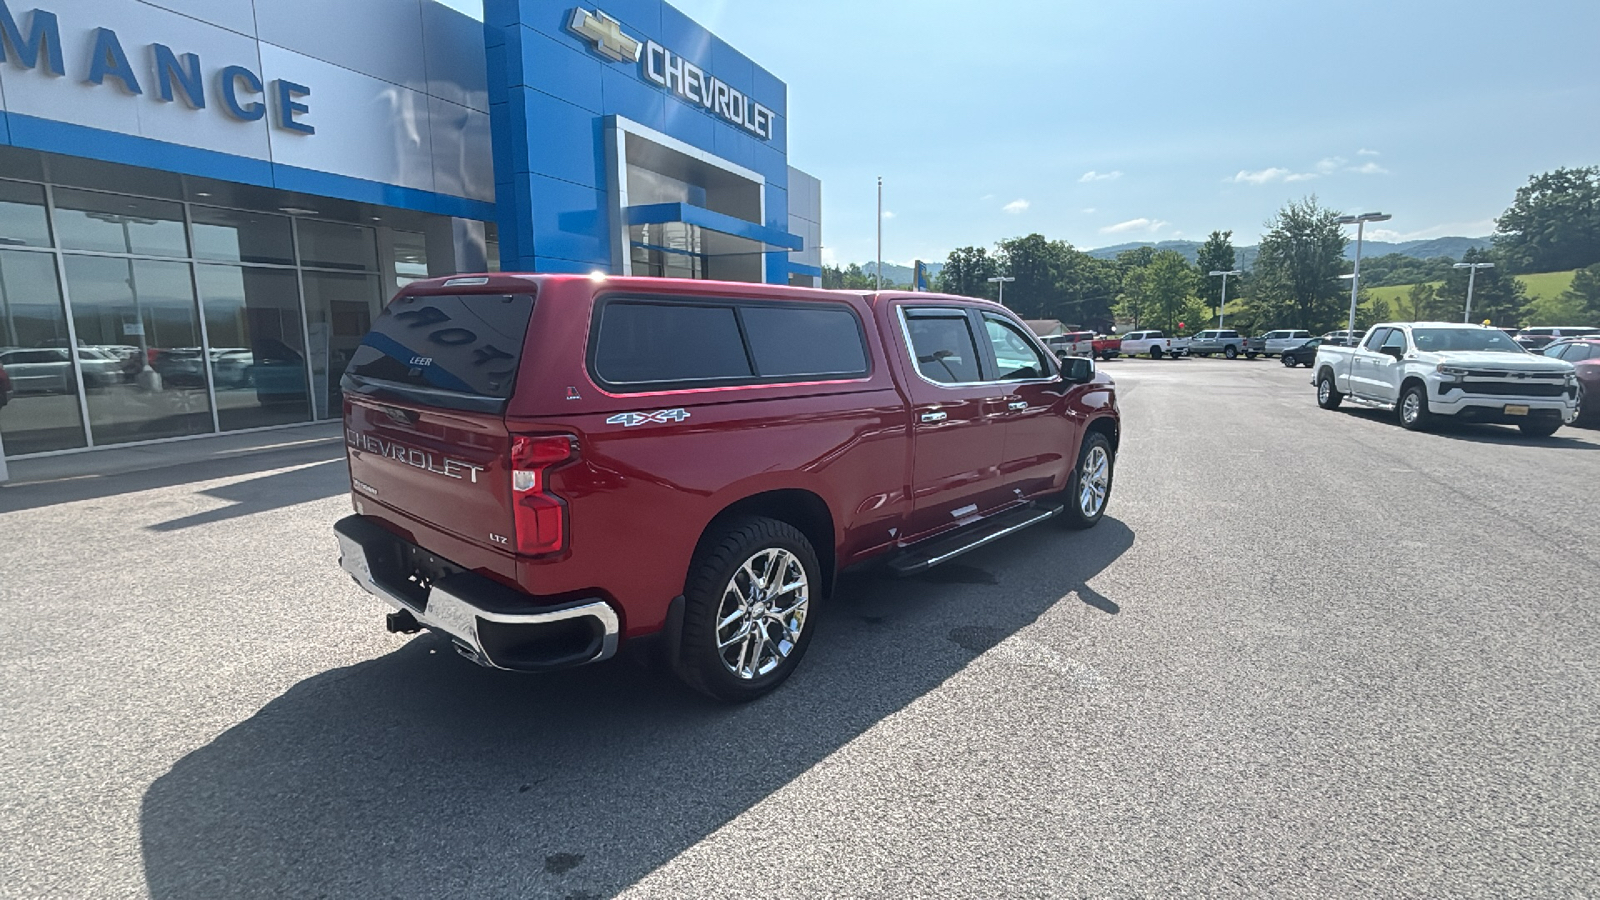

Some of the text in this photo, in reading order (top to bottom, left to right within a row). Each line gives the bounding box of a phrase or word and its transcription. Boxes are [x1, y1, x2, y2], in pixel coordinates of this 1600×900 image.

[0, 0, 315, 136] MANCE
[647, 39, 776, 141] CHEVROLET
[409, 356, 433, 366] LEER
[346, 428, 484, 483] CHEVROLET
[489, 532, 508, 545] LTZ
